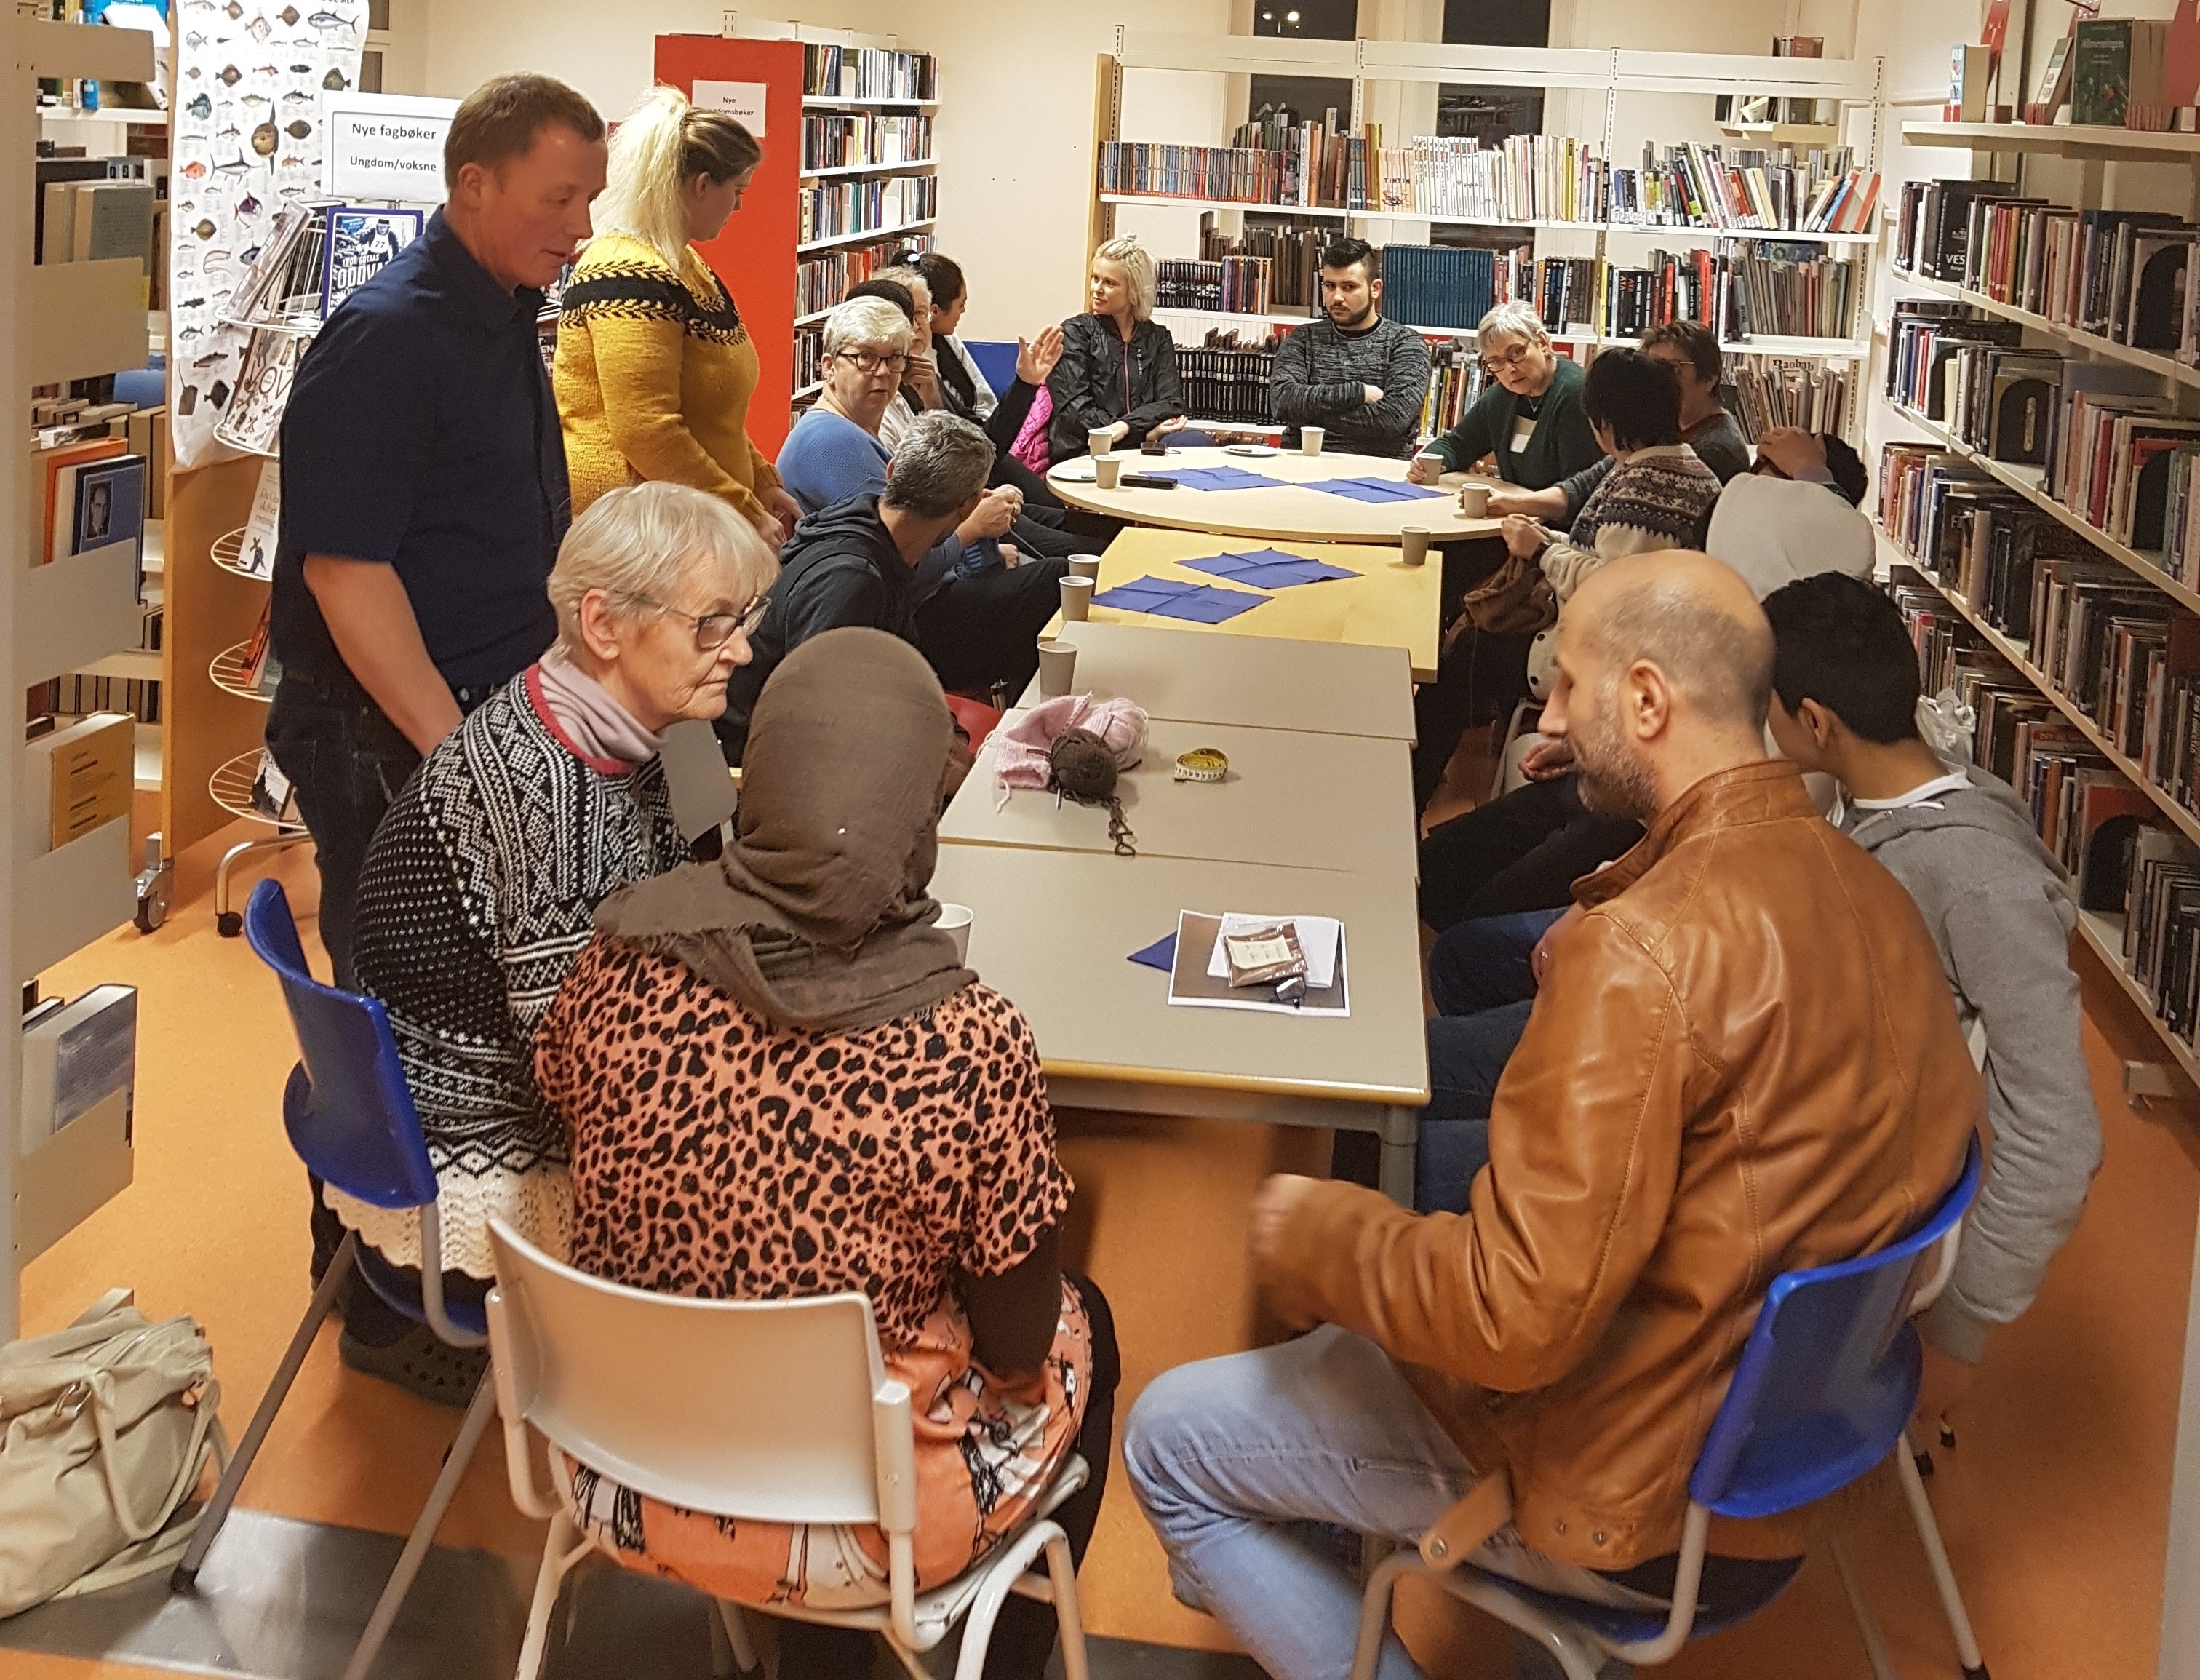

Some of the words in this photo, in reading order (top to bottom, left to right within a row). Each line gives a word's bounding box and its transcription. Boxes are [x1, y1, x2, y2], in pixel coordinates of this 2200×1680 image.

[722, 97, 736, 105] Nye
[714, 107, 754, 116] domsbøker
[351, 123, 376, 138] Nye
[380, 124, 437, 140] fagbøker
[350, 155, 437, 172] Ungdom/voksne
[375, 240, 386, 249] 77
[1945, 253, 1966, 265] VES
[336, 263, 384, 290] ODDV
